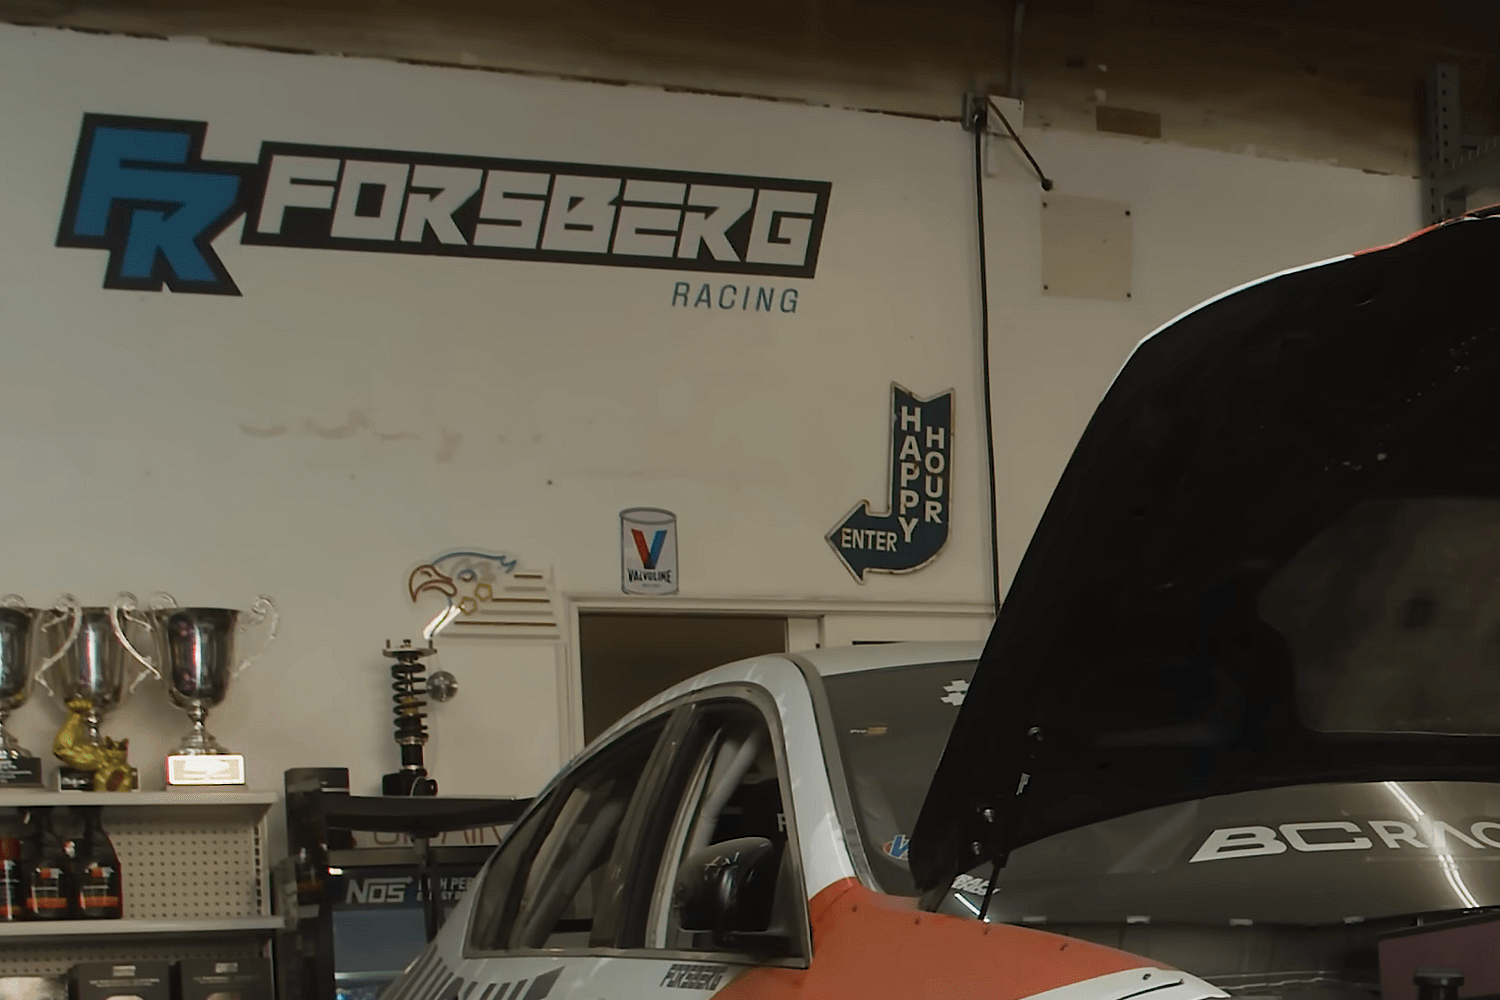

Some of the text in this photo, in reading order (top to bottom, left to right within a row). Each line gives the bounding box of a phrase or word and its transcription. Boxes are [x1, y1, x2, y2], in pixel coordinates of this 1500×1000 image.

[256, 153, 820, 268] FORSBERG
[671, 281, 800, 314] RACING
[899, 405, 922, 543] HAPPY
[924, 425, 946, 524] HOUR
[841, 527, 897, 552] ENTER
[346, 875, 413, 904] NOS
